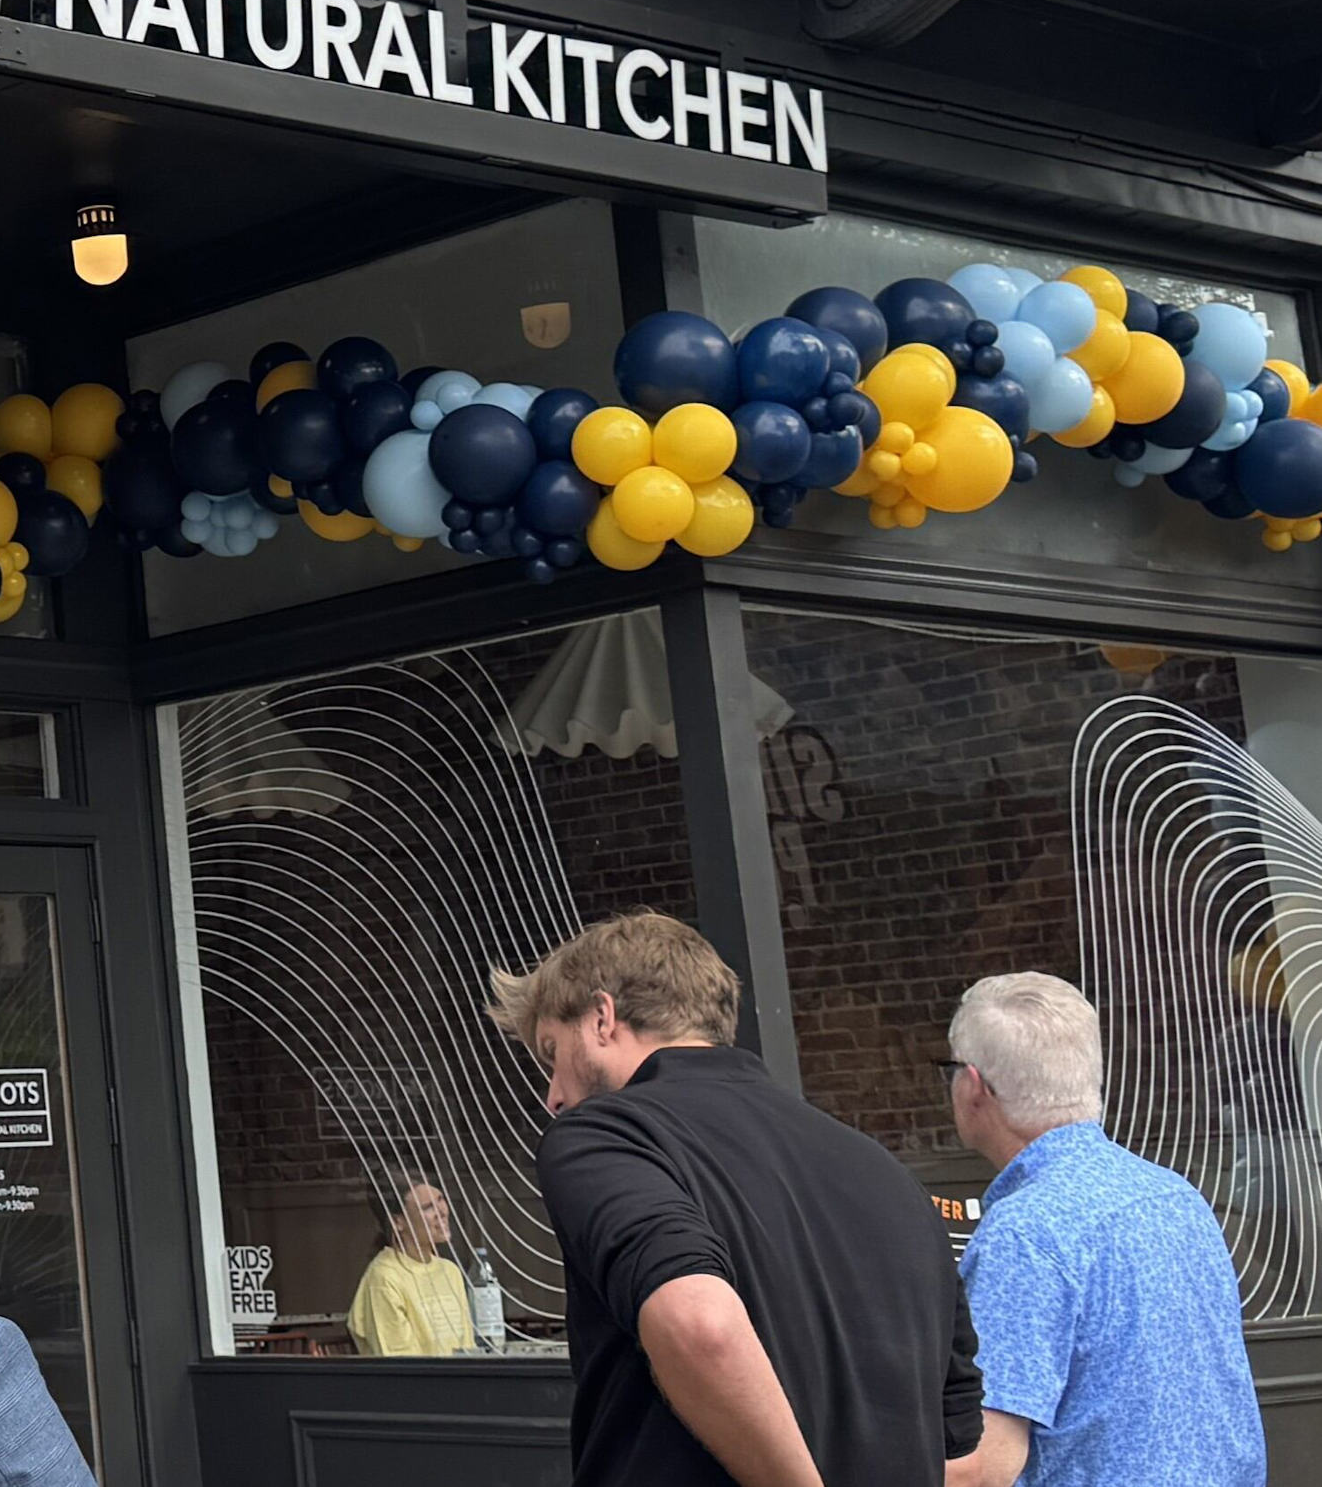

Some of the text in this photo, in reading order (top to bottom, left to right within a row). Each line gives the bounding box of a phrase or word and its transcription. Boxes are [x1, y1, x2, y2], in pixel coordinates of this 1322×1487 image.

[492, 22, 828, 173] KITCHEN
[8, 1123, 43, 1135] KITCHEN
[227, 1248, 270, 1269] KIDS
[230, 1271, 262, 1291] EAT
[231, 1293, 274, 1313] FREE
